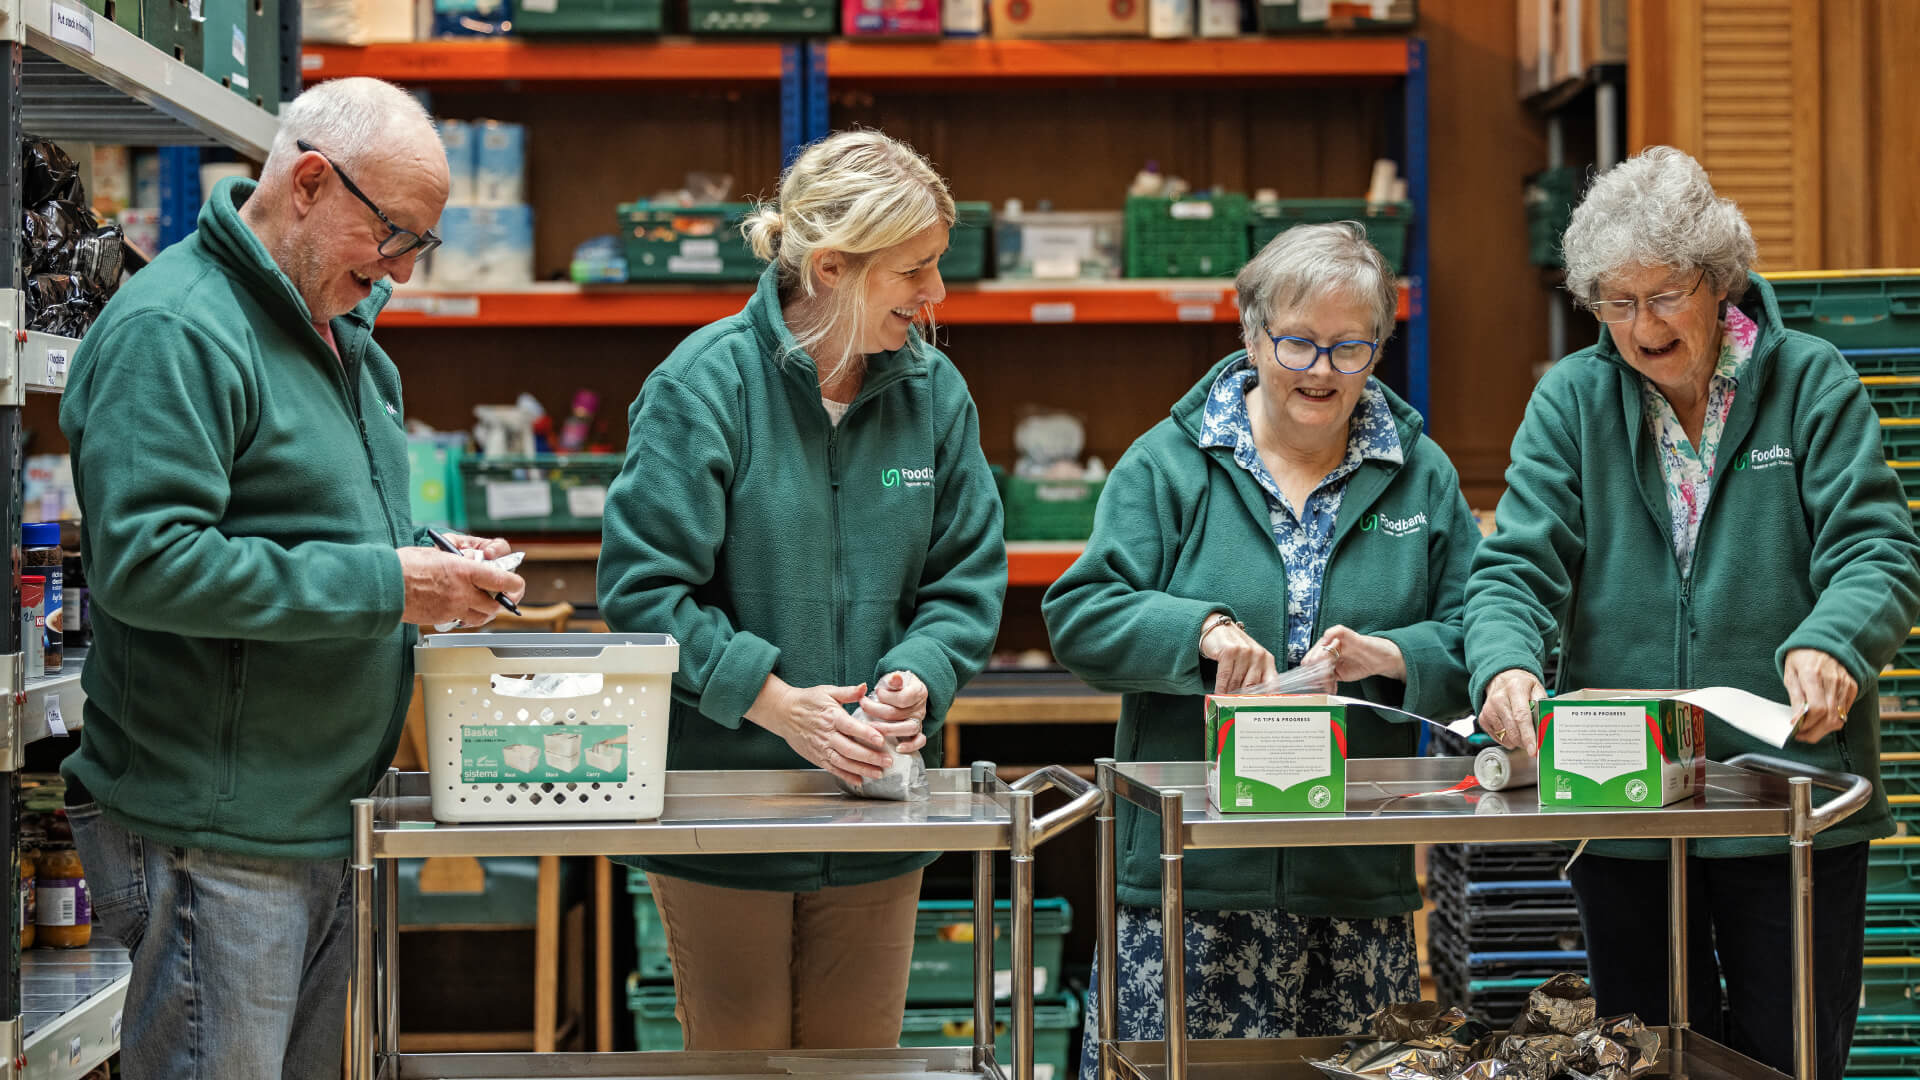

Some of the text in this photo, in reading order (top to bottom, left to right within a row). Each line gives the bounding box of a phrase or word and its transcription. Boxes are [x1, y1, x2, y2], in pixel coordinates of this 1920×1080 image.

[1751, 444, 1790, 462] Foodba
[901, 467, 934, 480] Foodb
[1380, 511, 1427, 531] Foodbank
[463, 727, 498, 737] Basket
[1679, 706, 1691, 750] PG
[464, 769, 498, 778] sistema
